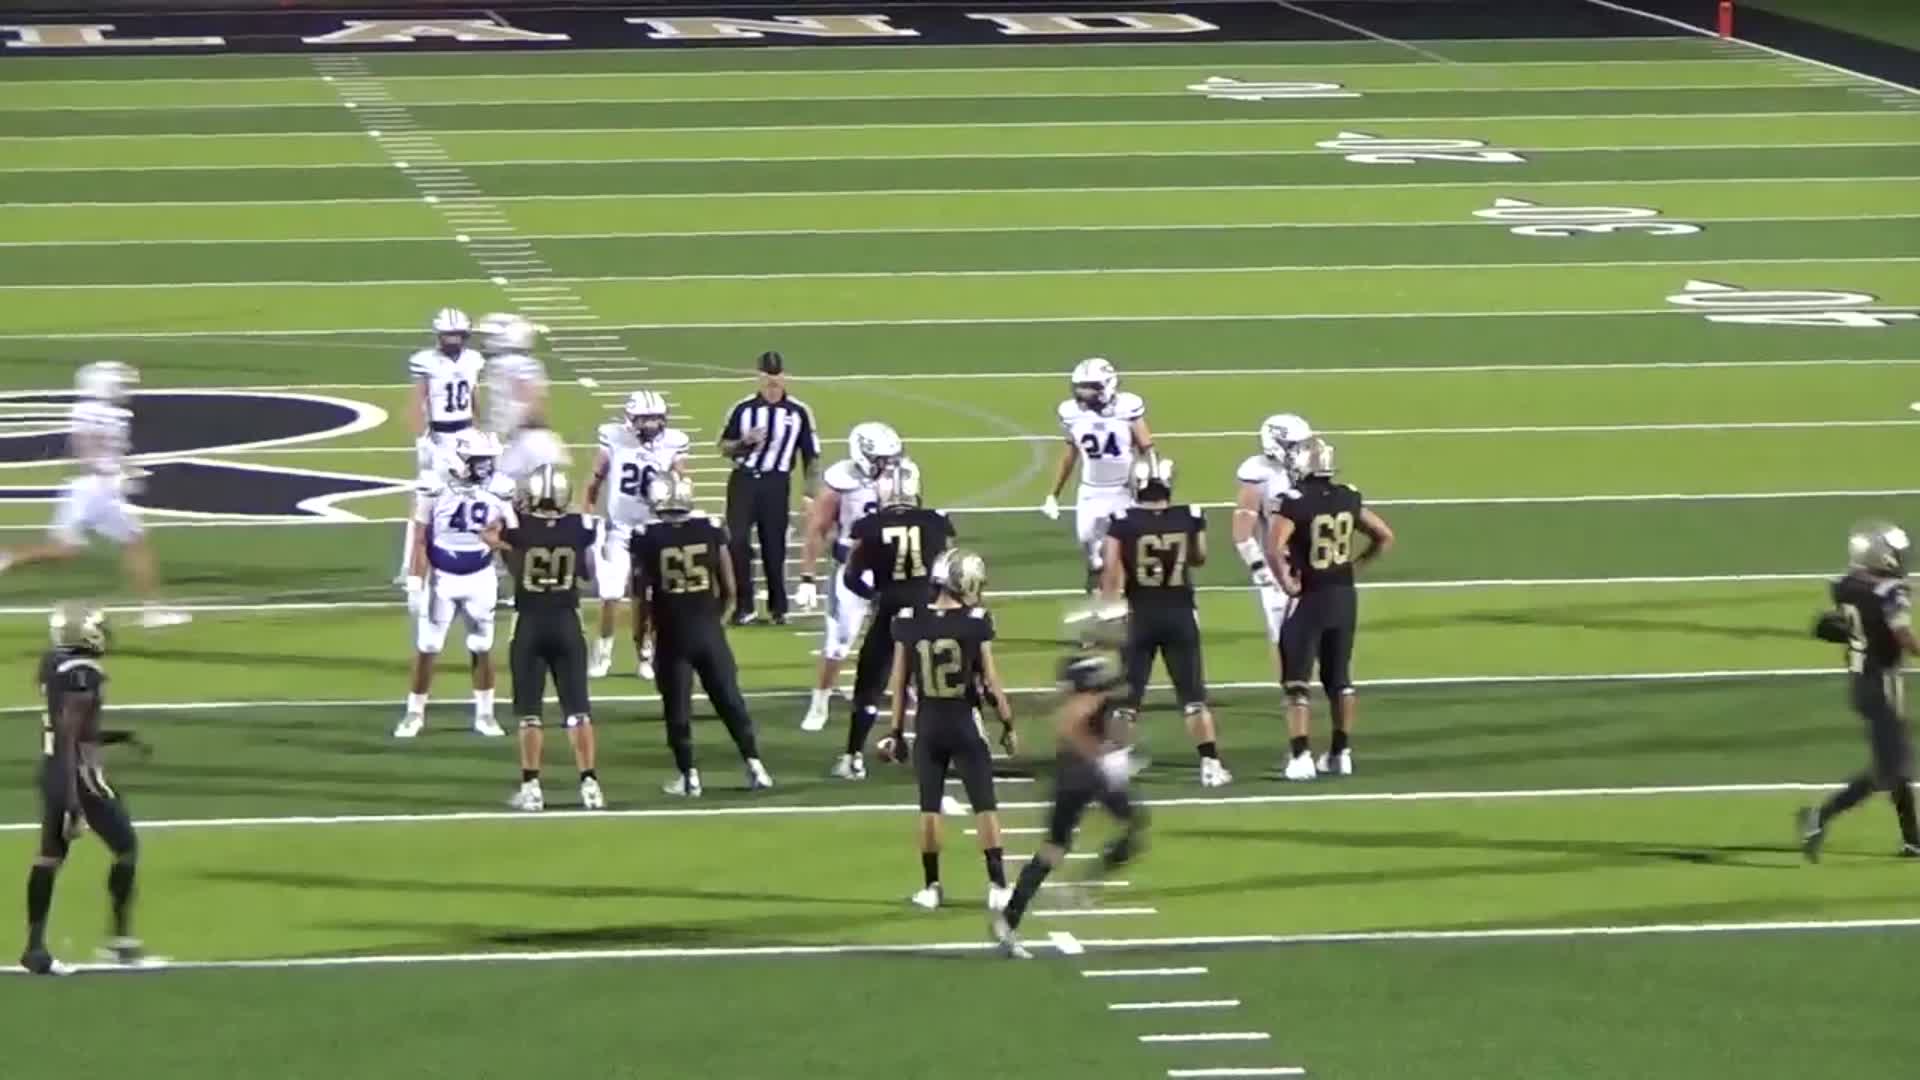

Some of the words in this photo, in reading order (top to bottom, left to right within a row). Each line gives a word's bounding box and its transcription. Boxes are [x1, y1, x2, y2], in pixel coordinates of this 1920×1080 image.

[1315, 138, 1527, 163] 20
[1472, 206, 1703, 236] 30
[1665, 290, 1920, 327] 40
[1080, 431, 1122, 460] 24
[881, 526, 928, 580] 71
[1135, 532, 1188, 587] 67
[1309, 511, 1354, 570] 68
[523, 547, 576, 592] 60
[659, 543, 709, 593] 65
[916, 638, 967, 698] 12
